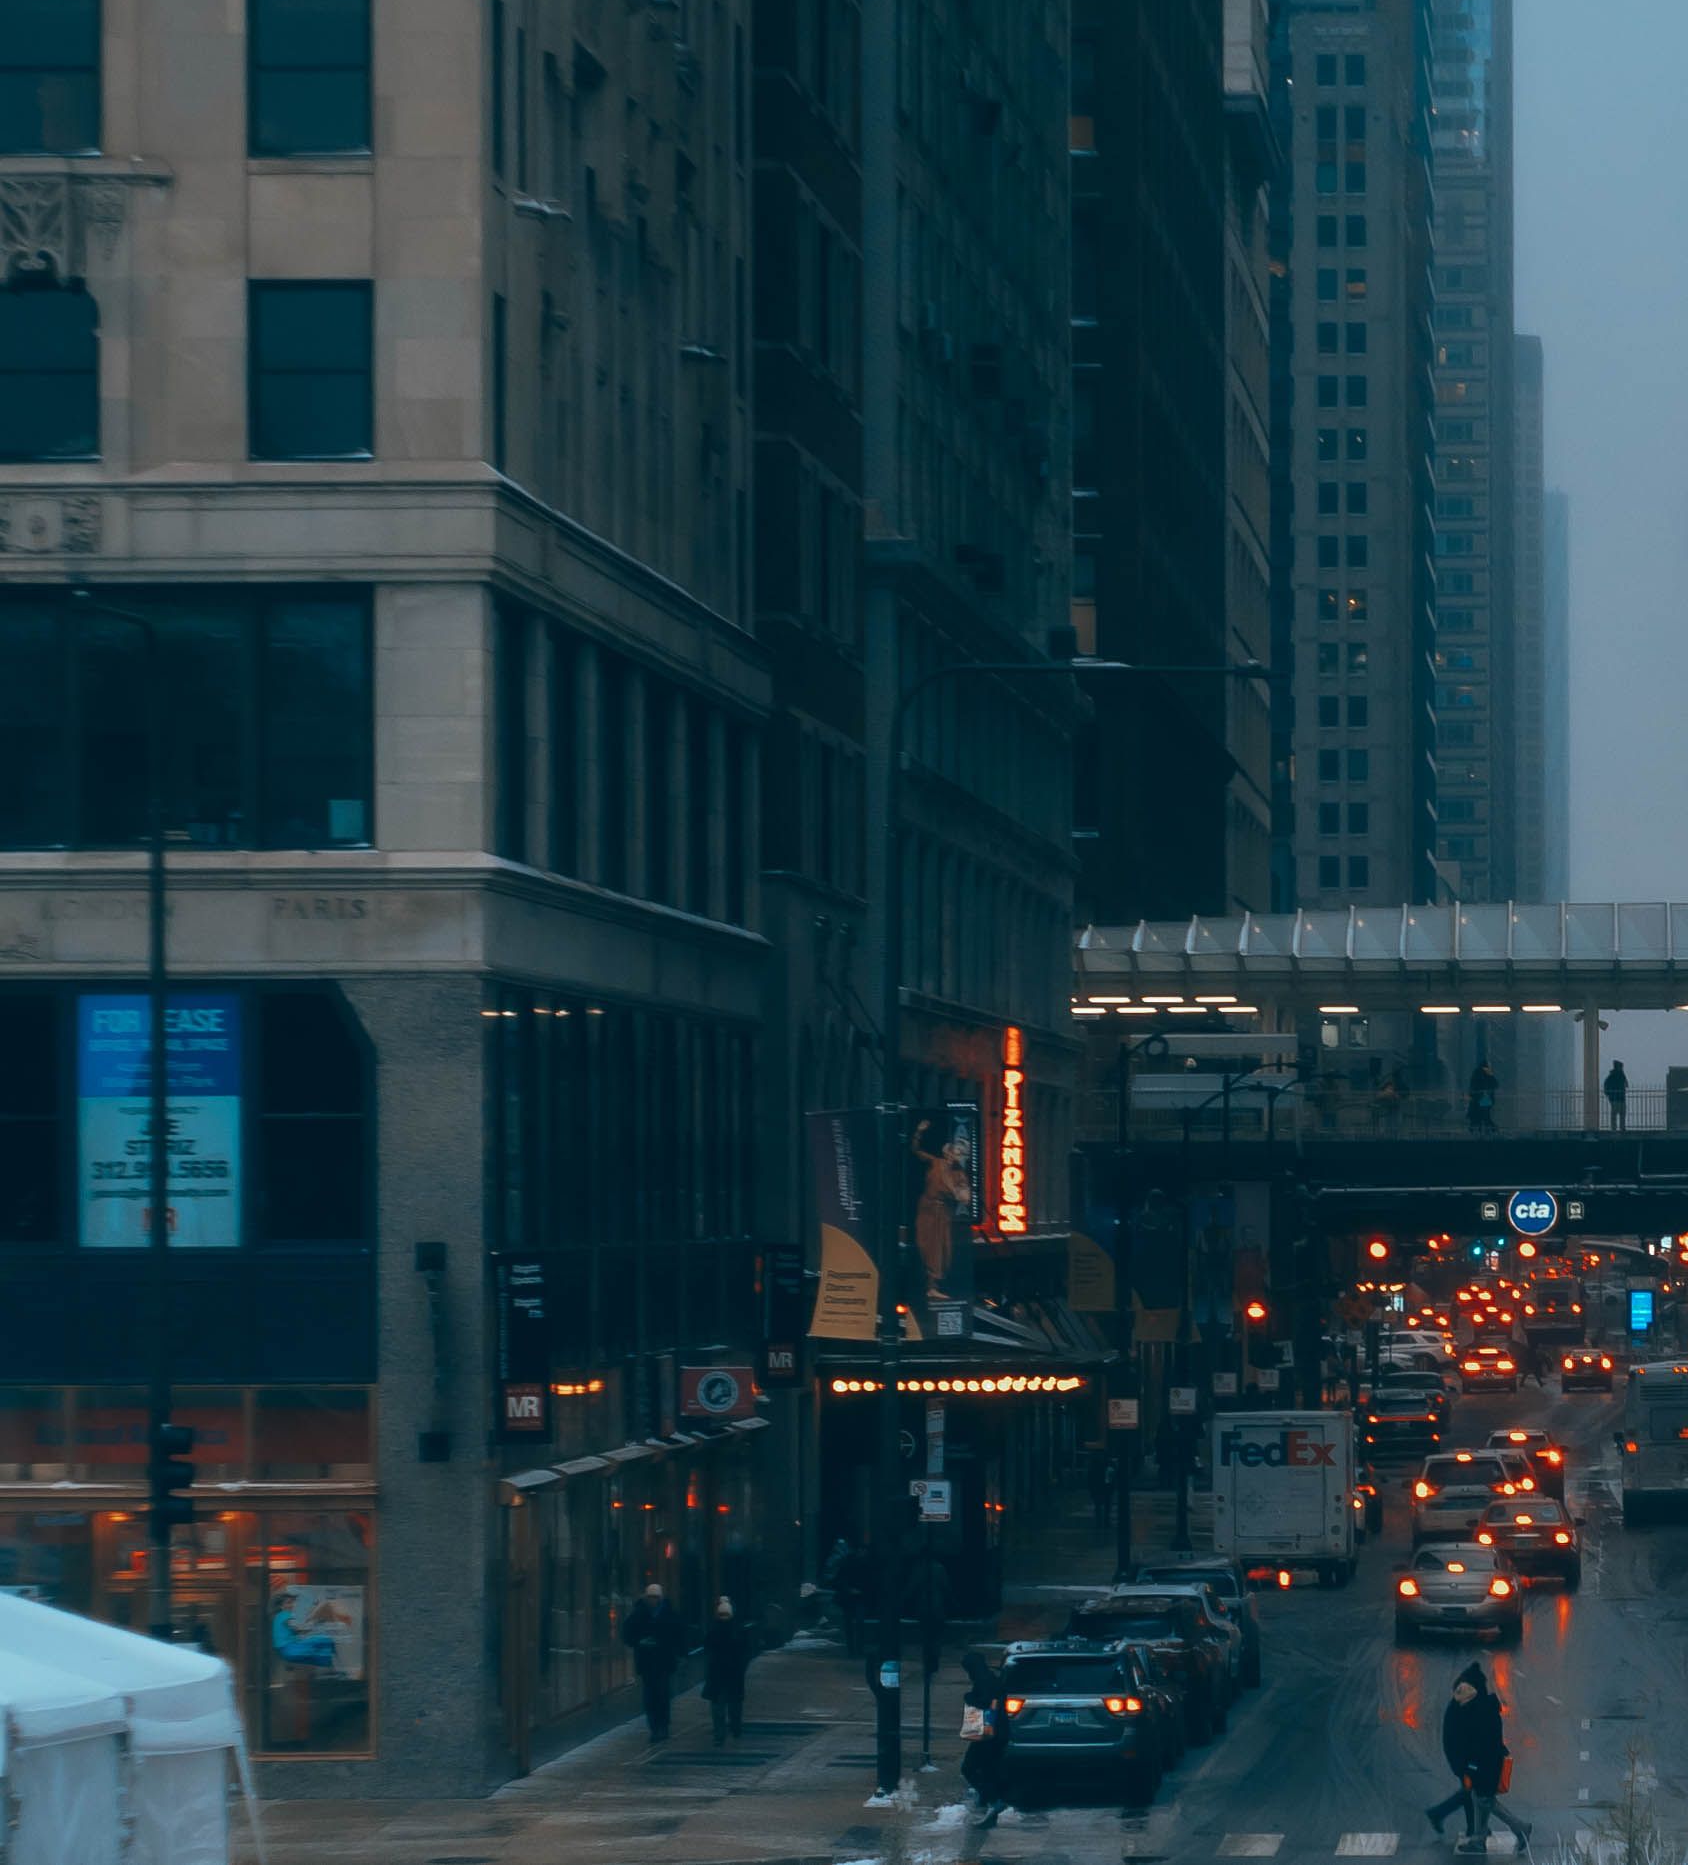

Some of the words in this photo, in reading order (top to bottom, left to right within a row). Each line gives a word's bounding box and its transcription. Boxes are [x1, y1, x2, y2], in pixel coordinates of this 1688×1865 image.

[273, 897, 368, 922] PARIS
[152, 1009, 225, 1033] EASE
[1515, 1201, 1551, 1219] cta
[507, 1396, 541, 1418] MR
[1220, 1430, 1337, 1467] FedEx
